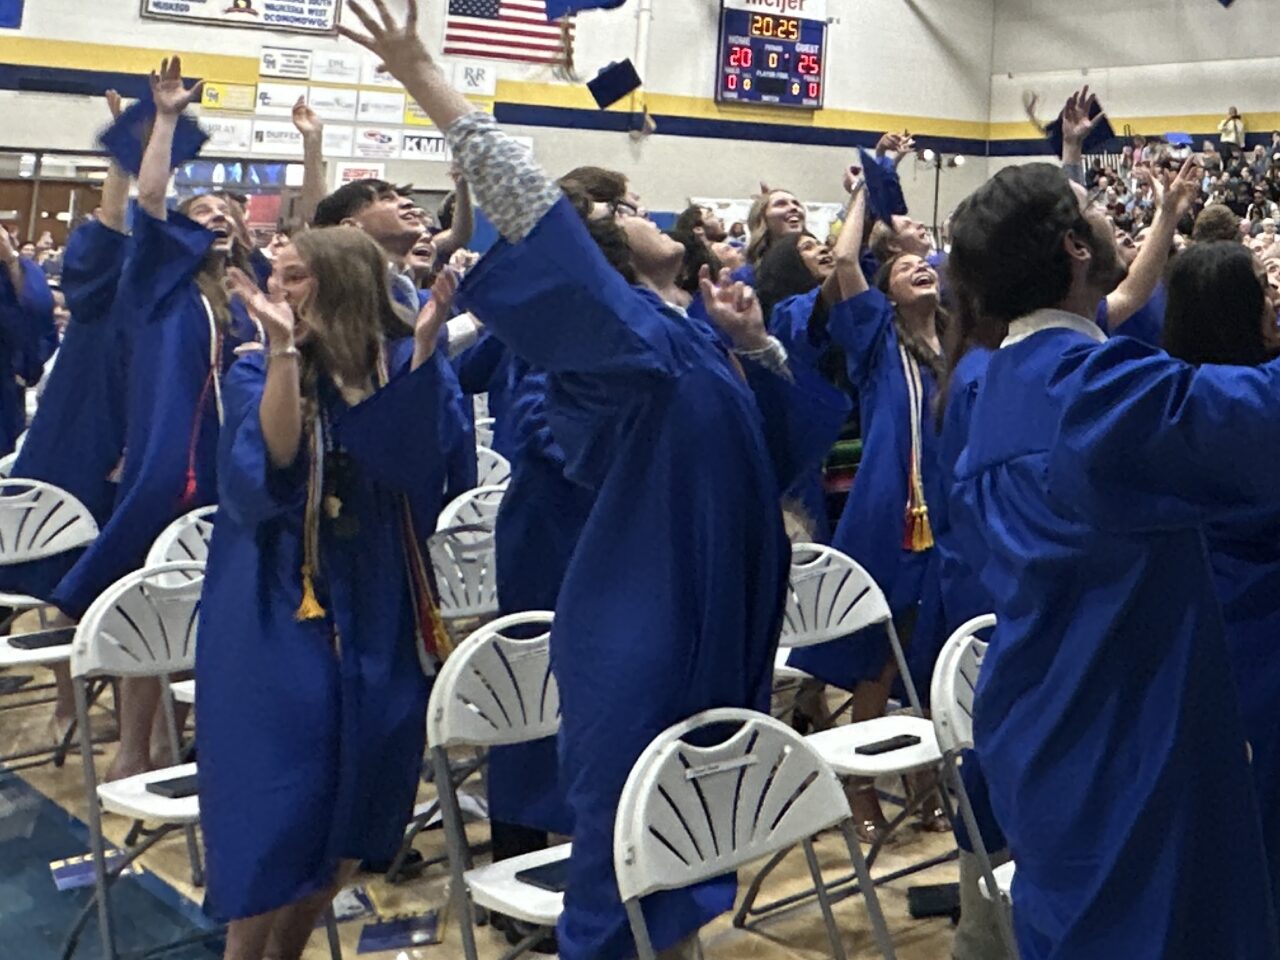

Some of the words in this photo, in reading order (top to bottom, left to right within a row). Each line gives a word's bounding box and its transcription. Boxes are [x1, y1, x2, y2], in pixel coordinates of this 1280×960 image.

[729, 47, 753, 68] 20
[768, 53, 778, 68] 0
[797, 55, 820, 74] 25
[727, 74, 737, 90] 0
[808, 82, 818, 97] 0
